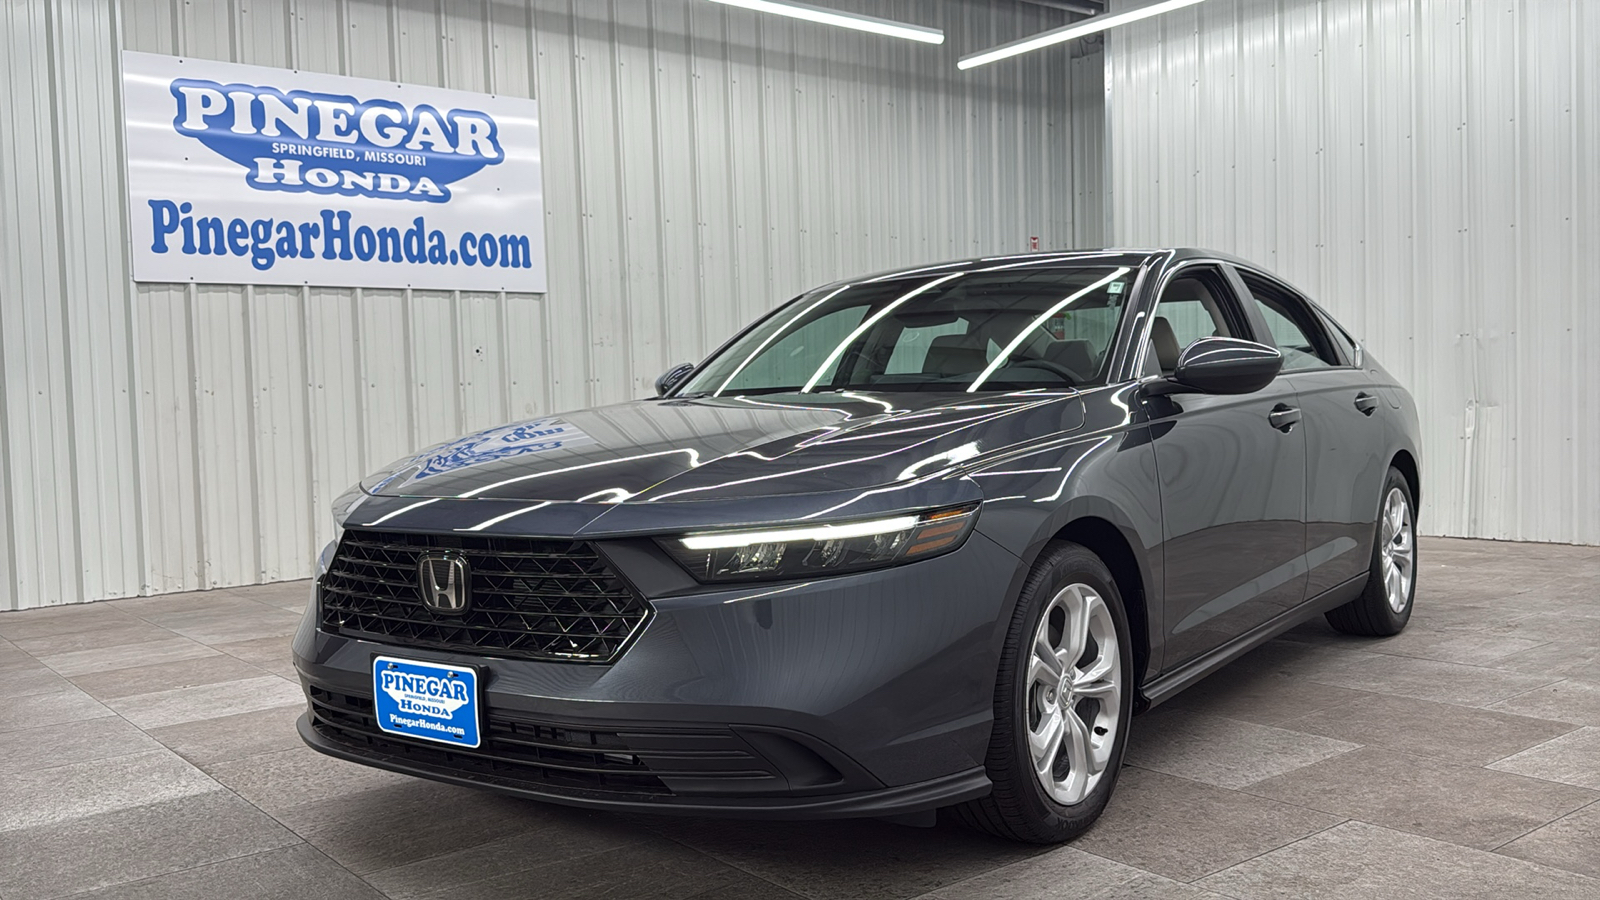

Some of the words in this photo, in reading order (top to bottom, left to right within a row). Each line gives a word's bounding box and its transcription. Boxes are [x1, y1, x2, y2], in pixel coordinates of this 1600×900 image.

[177, 86, 500, 160] PINEGAR
[271, 142, 360, 163] SPRINGFIELD,
[364, 150, 427, 167] MISSOURI
[252, 157, 445, 197] HONDA
[148, 199, 532, 271] PinegarHonda.com
[383, 672, 467, 702] PINEGAR
[400, 699, 451, 717] HONDA
[390, 713, 465, 735] PinegarHonda.com
